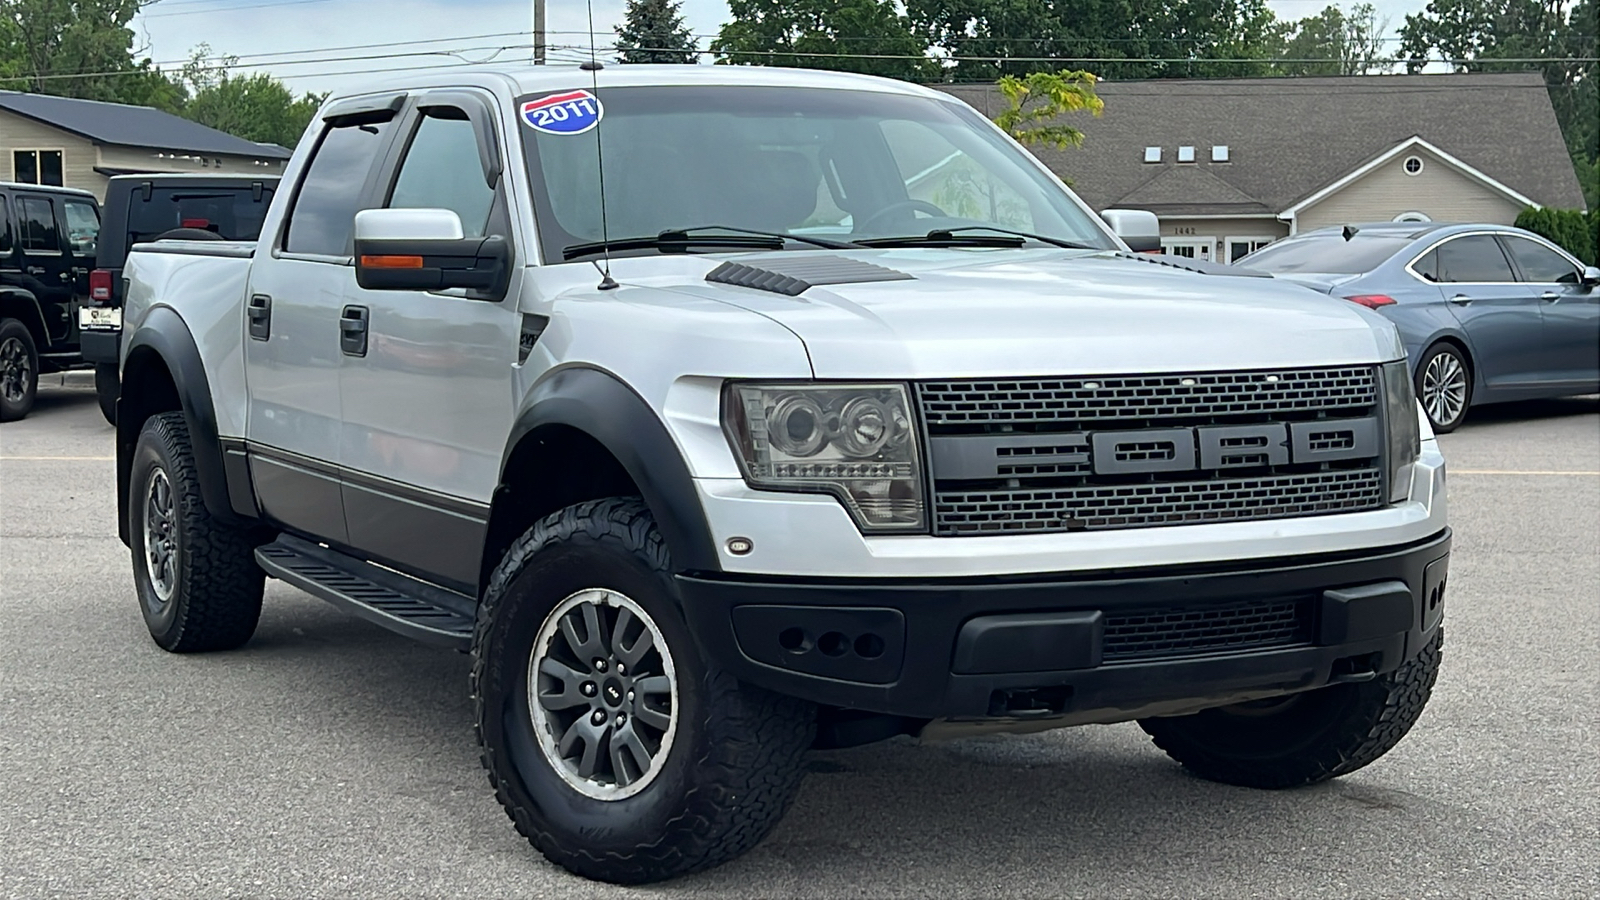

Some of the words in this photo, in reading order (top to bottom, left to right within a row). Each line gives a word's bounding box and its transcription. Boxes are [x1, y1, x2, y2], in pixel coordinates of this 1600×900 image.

[532, 99, 597, 127] 2011
[1174, 227, 1196, 235] 1442
[929, 417, 1379, 480] FORD
